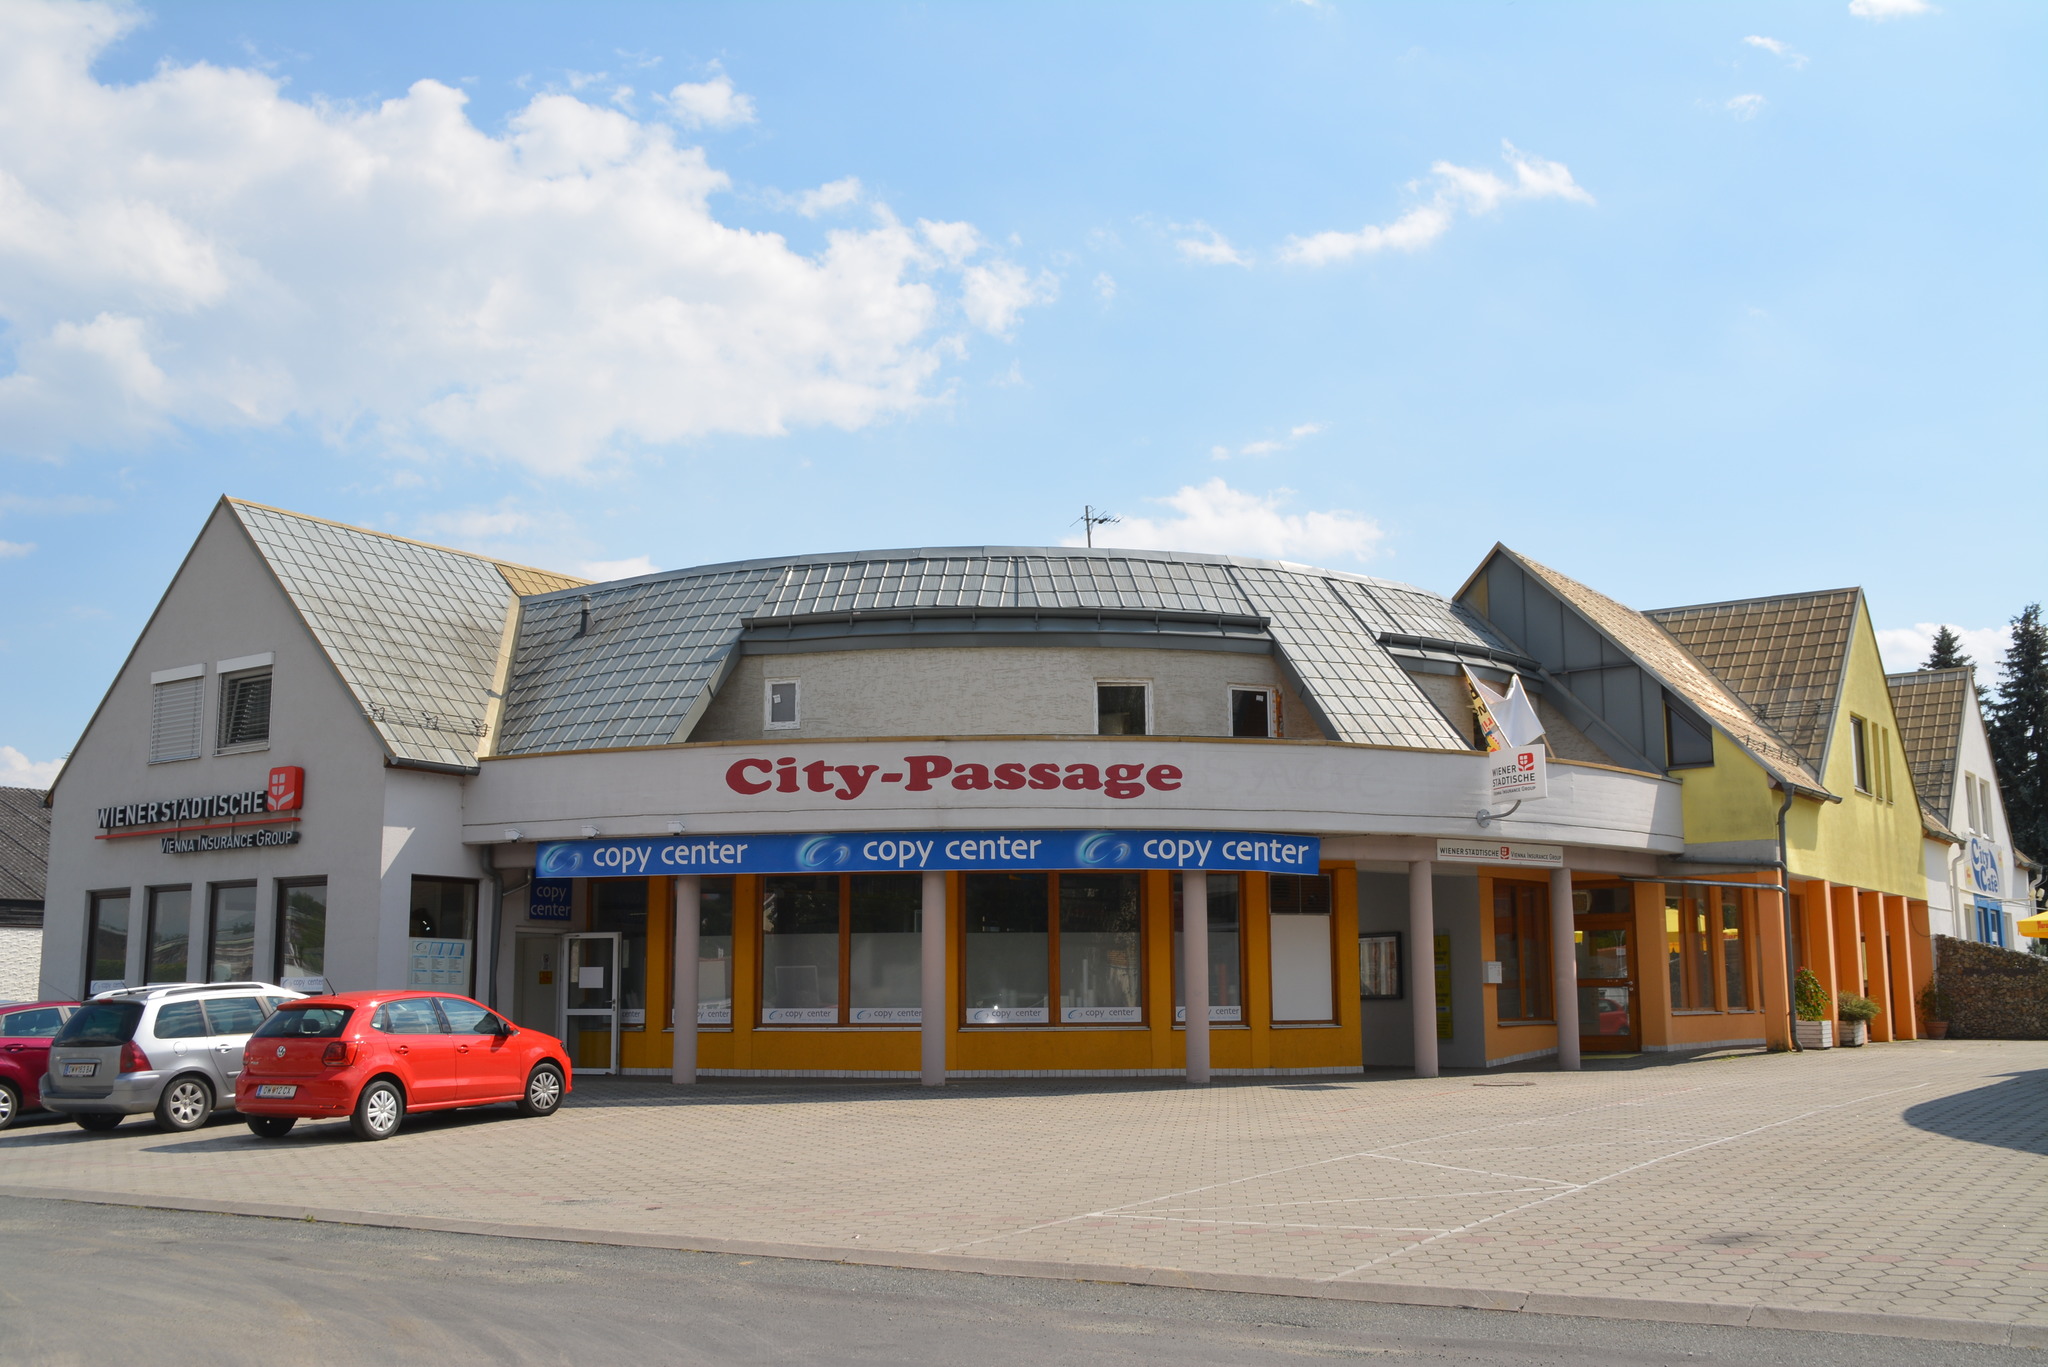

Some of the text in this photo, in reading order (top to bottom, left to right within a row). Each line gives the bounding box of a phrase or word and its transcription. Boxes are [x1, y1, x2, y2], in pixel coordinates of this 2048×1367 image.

[1492, 764, 1517, 777] WIENER
[726, 755, 1183, 800] City-Passage
[96, 790, 265, 828] WIENER STÄDTISCHE
[593, 840, 748, 873] copy center
[863, 836, 1042, 868] copy center
[1143, 839, 1309, 867] copy center
[1440, 847, 1464, 855] WIENER
[1971, 838, 1990, 870] City
[536, 886, 567, 902] copy
[530, 903, 571, 917] center
[707, 1009, 730, 1018] center
[785, 1009, 832, 1018] copy center
[874, 1010, 893, 1018] copy
[992, 1008, 1042, 1018] copy center
[1085, 1008, 1134, 1017] copy center
[1215, 1007, 1240, 1015] center
